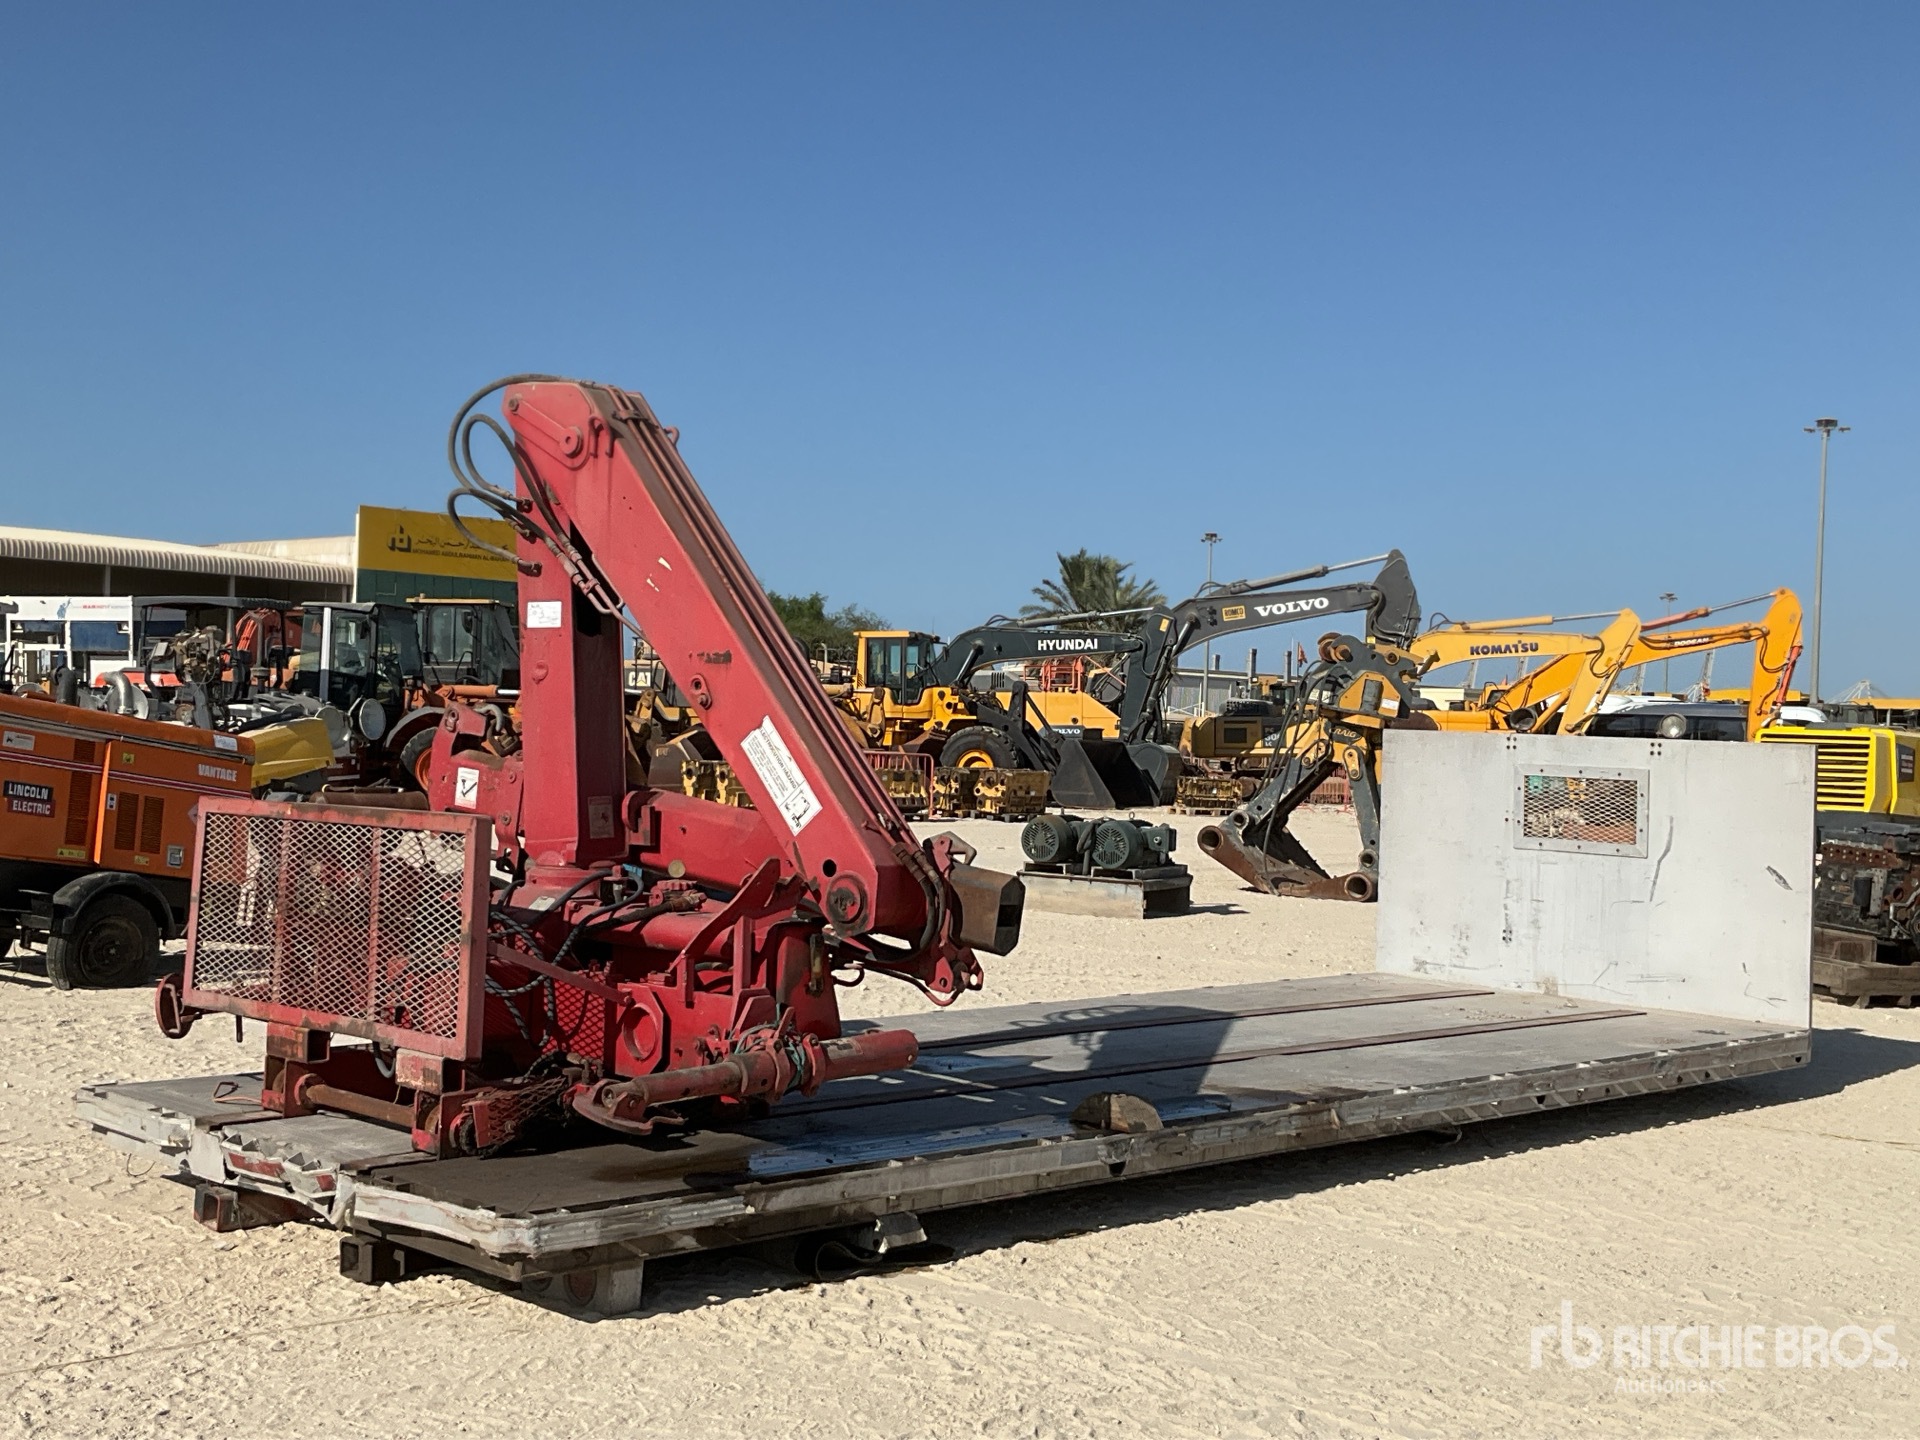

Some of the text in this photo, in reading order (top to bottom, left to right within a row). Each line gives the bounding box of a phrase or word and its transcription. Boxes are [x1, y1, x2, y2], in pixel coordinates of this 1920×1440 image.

[1253, 597, 1330, 617] VOLVO
[1037, 638, 1098, 651] HYUNDAI
[1469, 640, 1539, 656] KOMATSU
[628, 671, 651, 687] CAT
[198, 763, 238, 782] VANTAGE
[8, 782, 49, 800] LINCOLN
[12, 800, 51, 815] ELECTRIC
